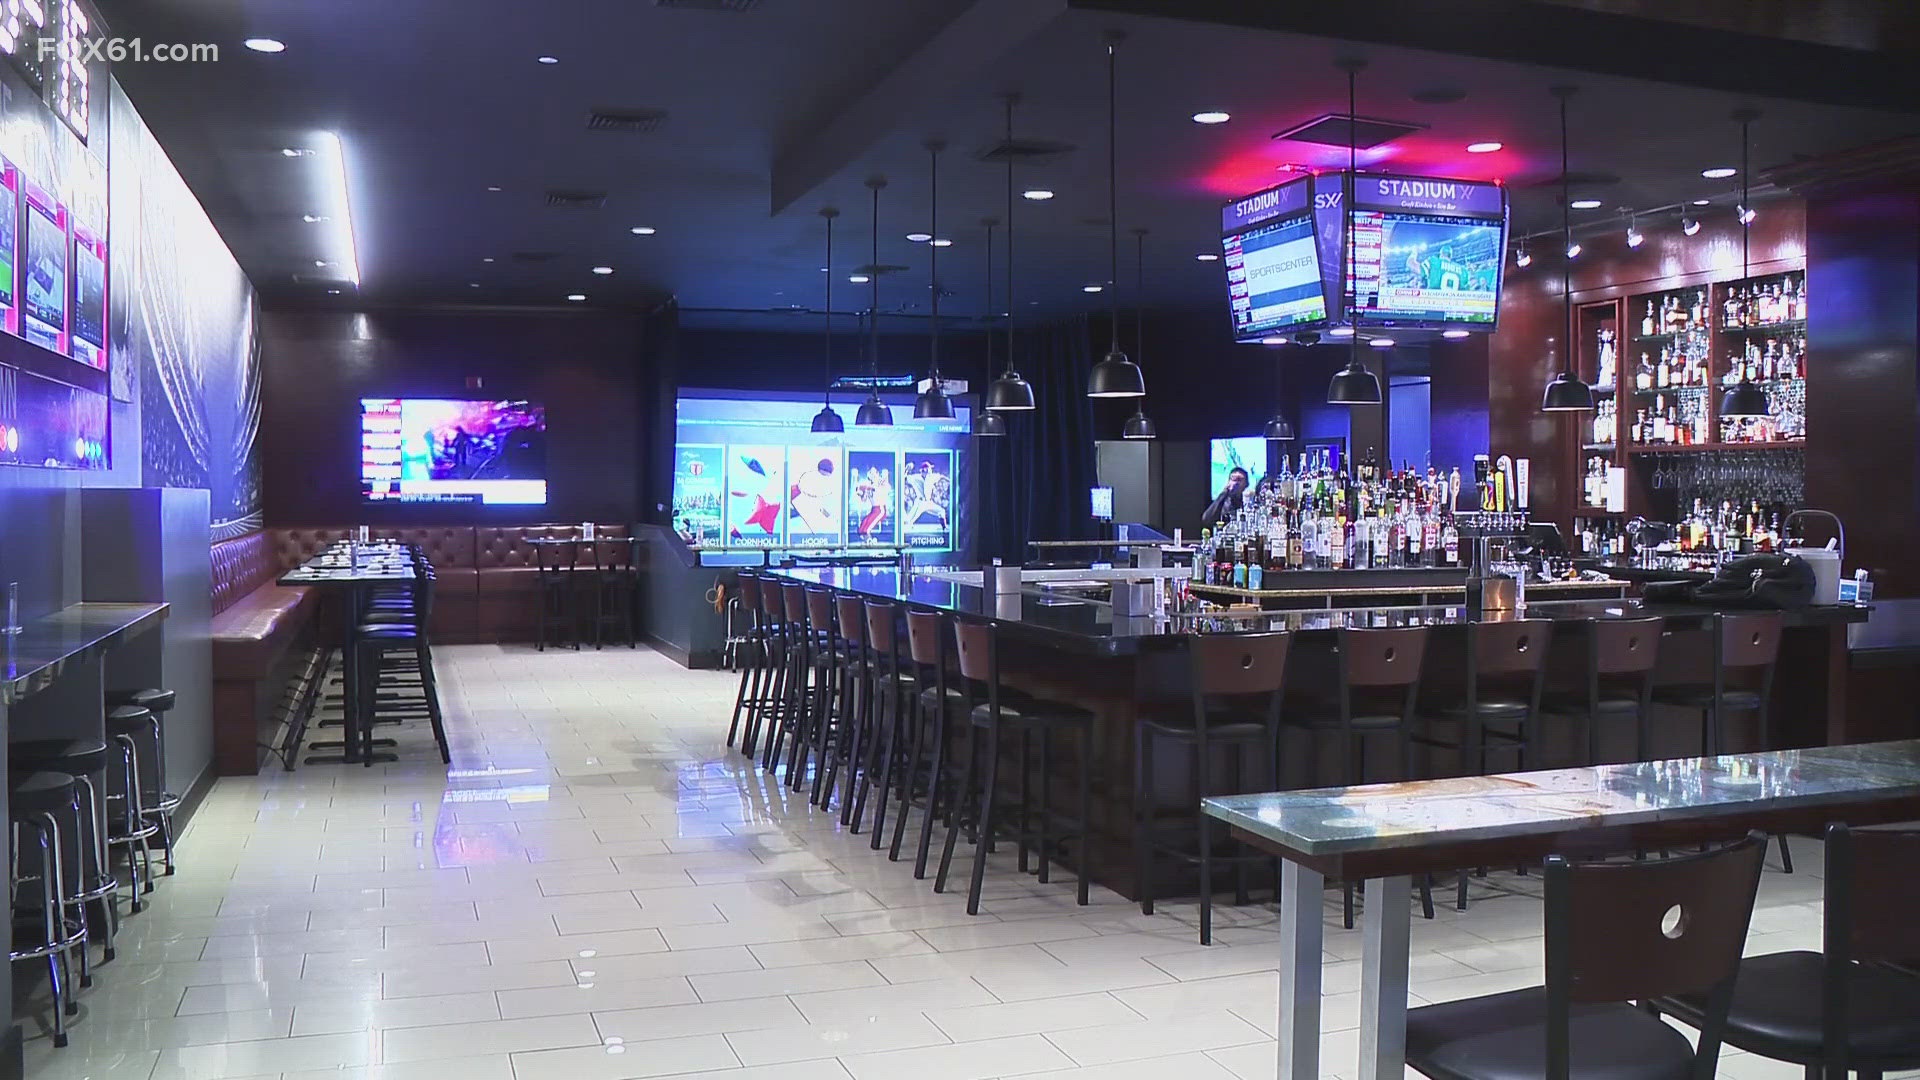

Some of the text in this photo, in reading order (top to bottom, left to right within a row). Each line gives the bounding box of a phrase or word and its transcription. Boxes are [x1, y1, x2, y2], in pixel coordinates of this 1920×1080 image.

[1379, 180, 1456, 200] STADIUM
[1236, 190, 1279, 217] STADIUM
[1249, 255, 1313, 280] SPORTSCENTER
[734, 537, 777, 547] CORNHOLE
[801, 537, 829, 546] HOOPS
[910, 536, 945, 546] PITCHING
